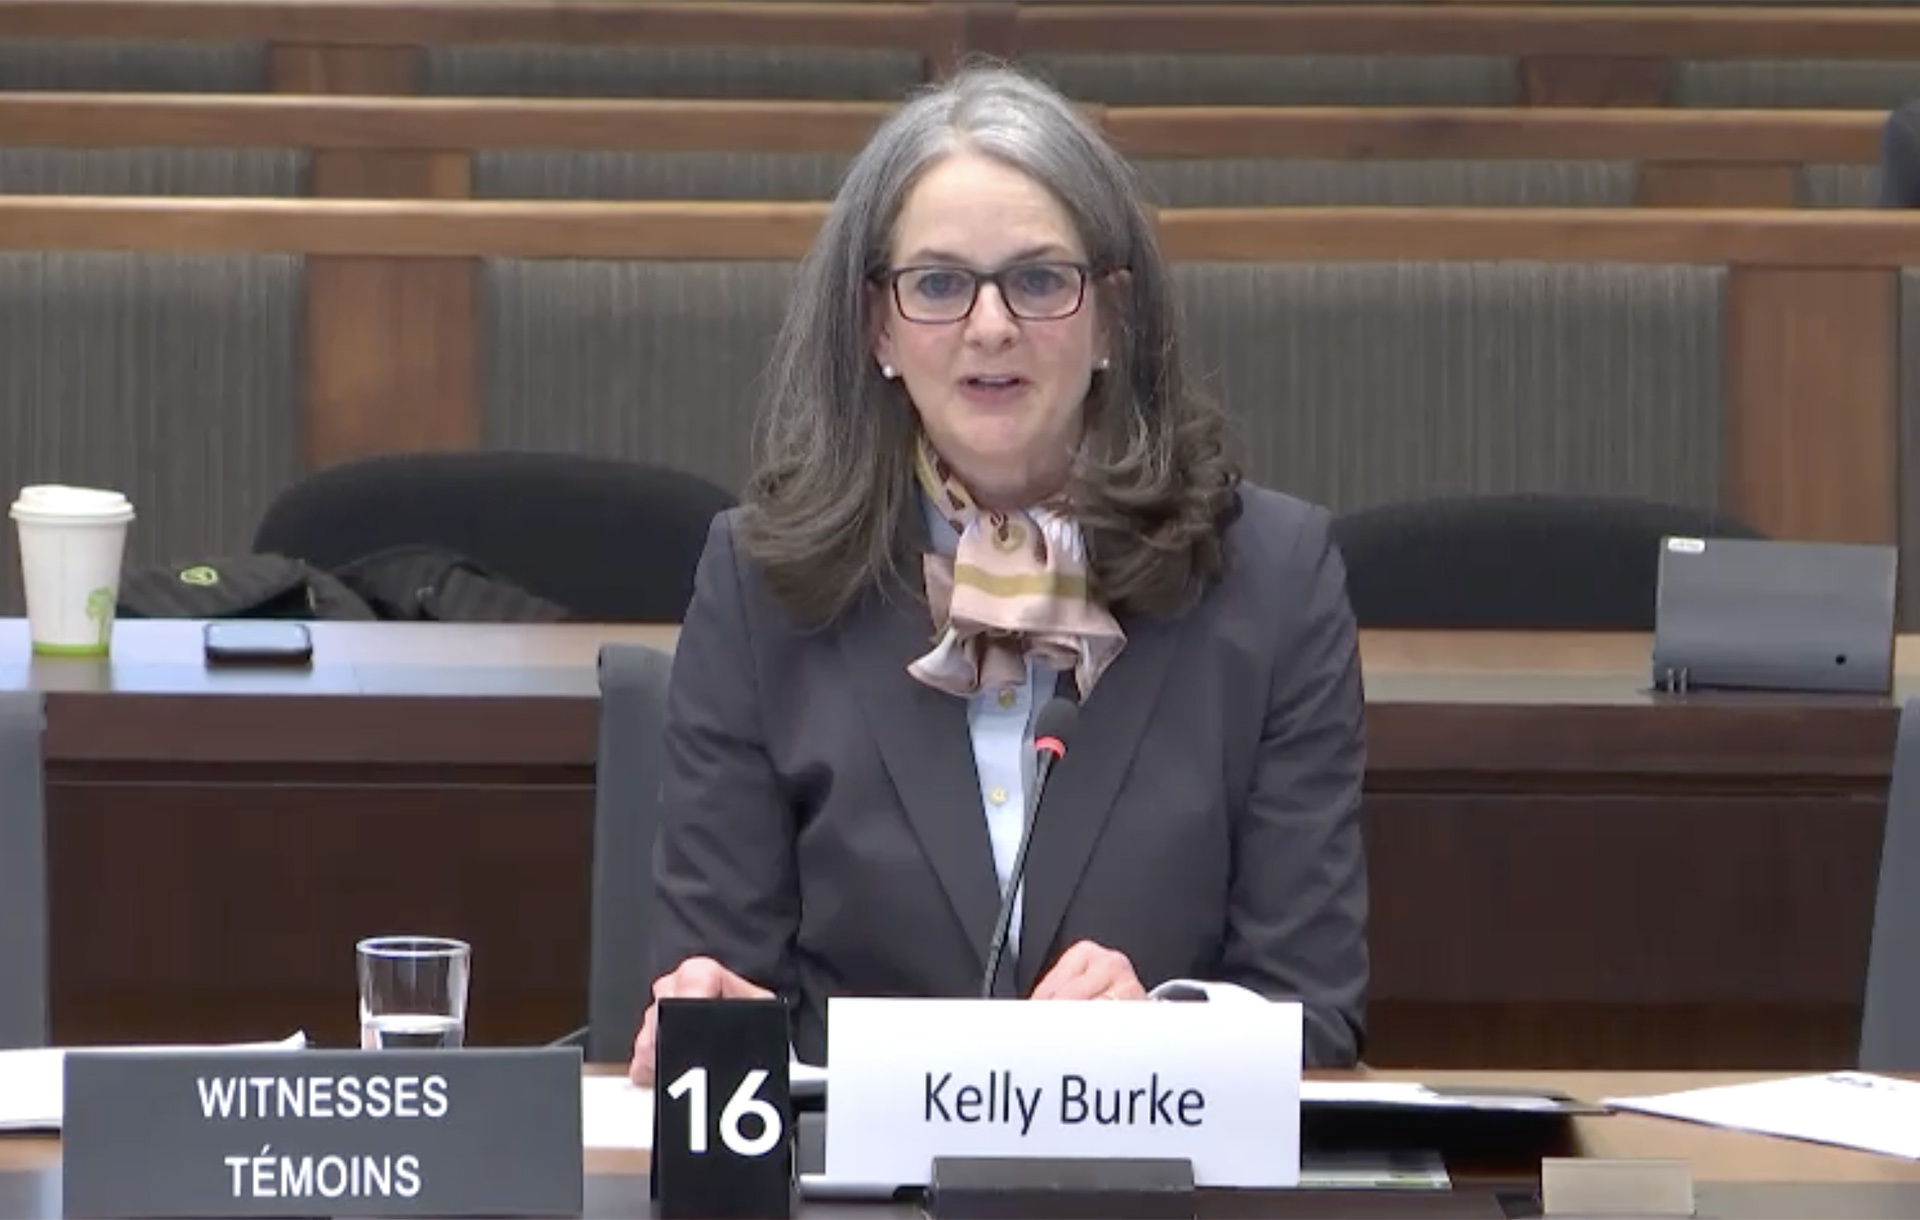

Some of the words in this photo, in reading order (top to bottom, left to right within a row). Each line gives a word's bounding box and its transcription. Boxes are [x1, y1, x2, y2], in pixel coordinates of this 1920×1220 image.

[196, 1074, 449, 1119] WITNESSES
[667, 1067, 782, 1156] 16
[925, 1071, 1042, 1136] Kelly
[1060, 1072, 1205, 1128] Burke
[224, 1143, 422, 1198] TÉMOINS
